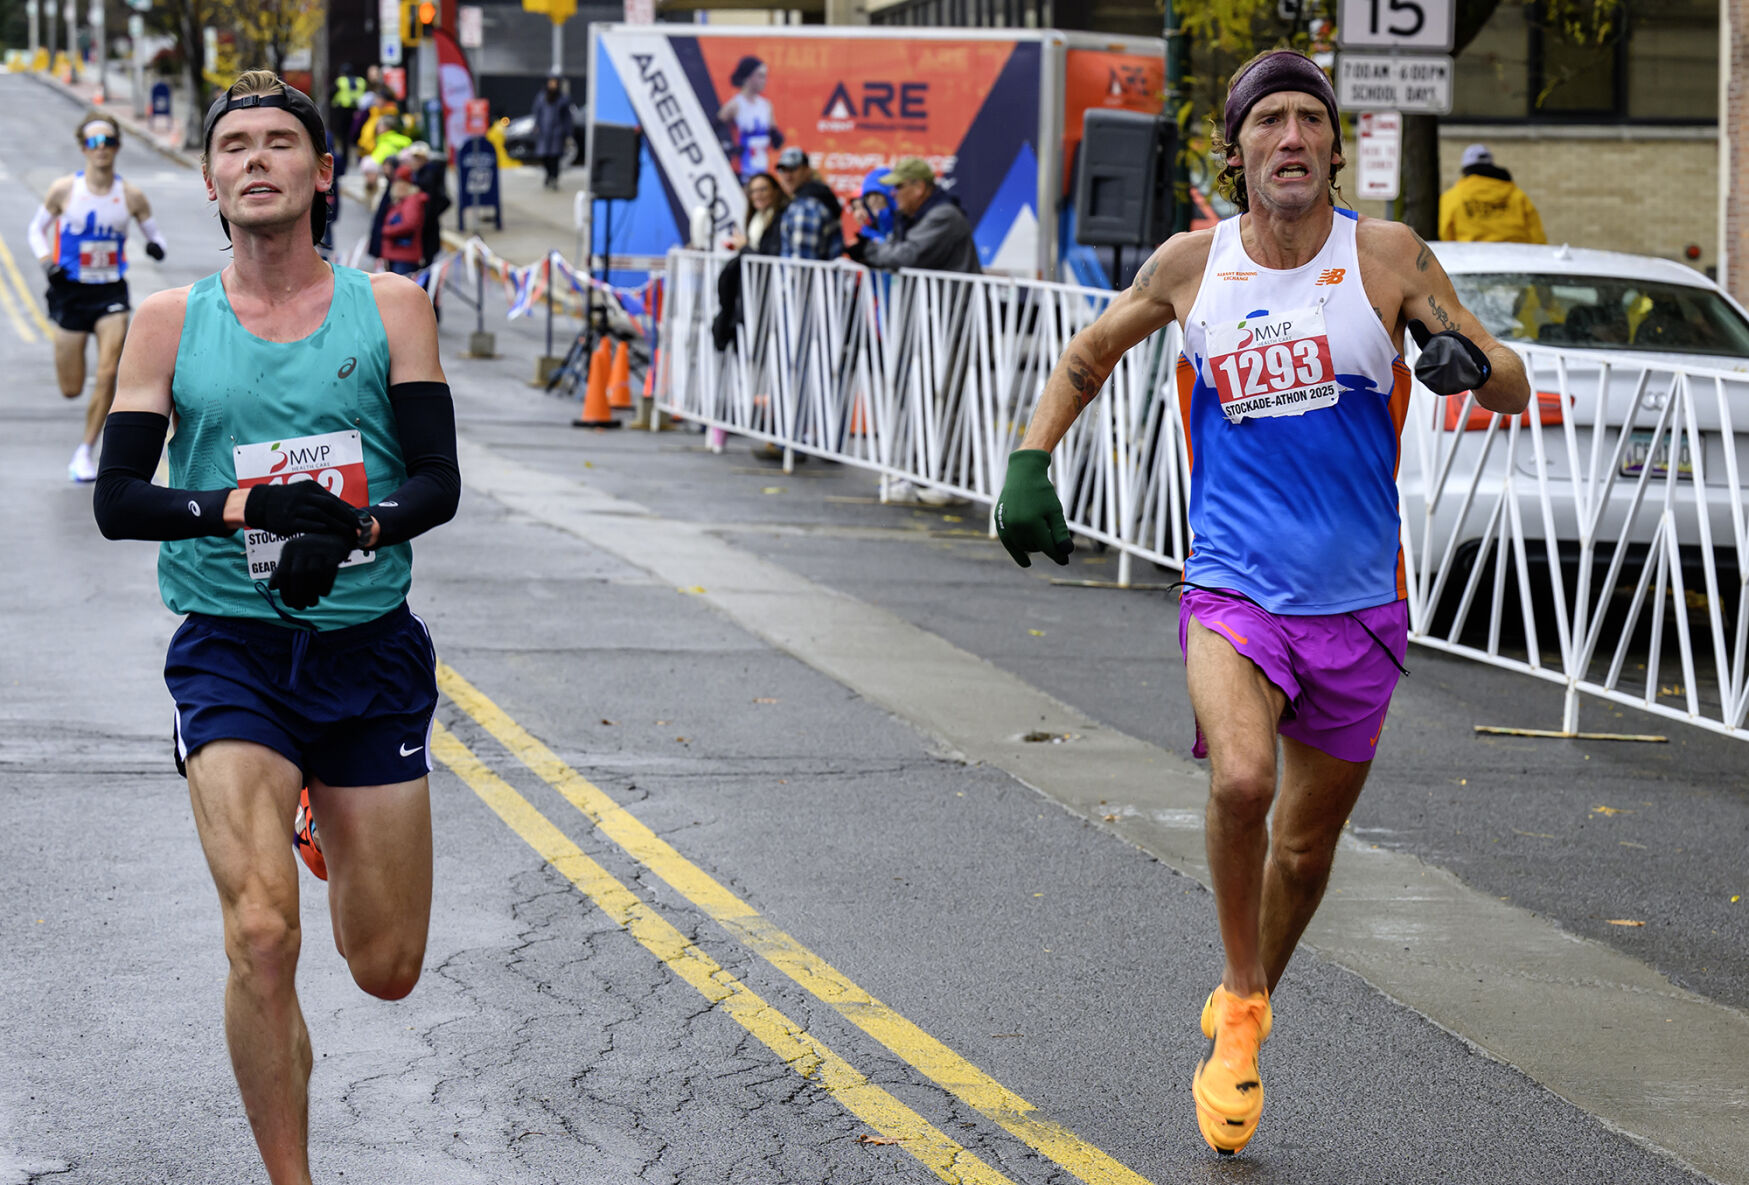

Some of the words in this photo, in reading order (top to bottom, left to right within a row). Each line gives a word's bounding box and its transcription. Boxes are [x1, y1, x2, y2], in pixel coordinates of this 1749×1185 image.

[1369, 0, 1425, 37] 15
[821, 80, 929, 119] ARE
[1351, 84, 1398, 101] SCHOOL
[1255, 321, 1292, 342] MVP
[1257, 339, 1277, 347] HEALTH
[1219, 339, 1323, 399] 1293
[1225, 390, 1308, 416] STOCKADE-ATHON
[1309, 385, 1335, 399] 2025
[290, 445, 330, 466] MVP
[291, 463, 315, 471] HEALTH
